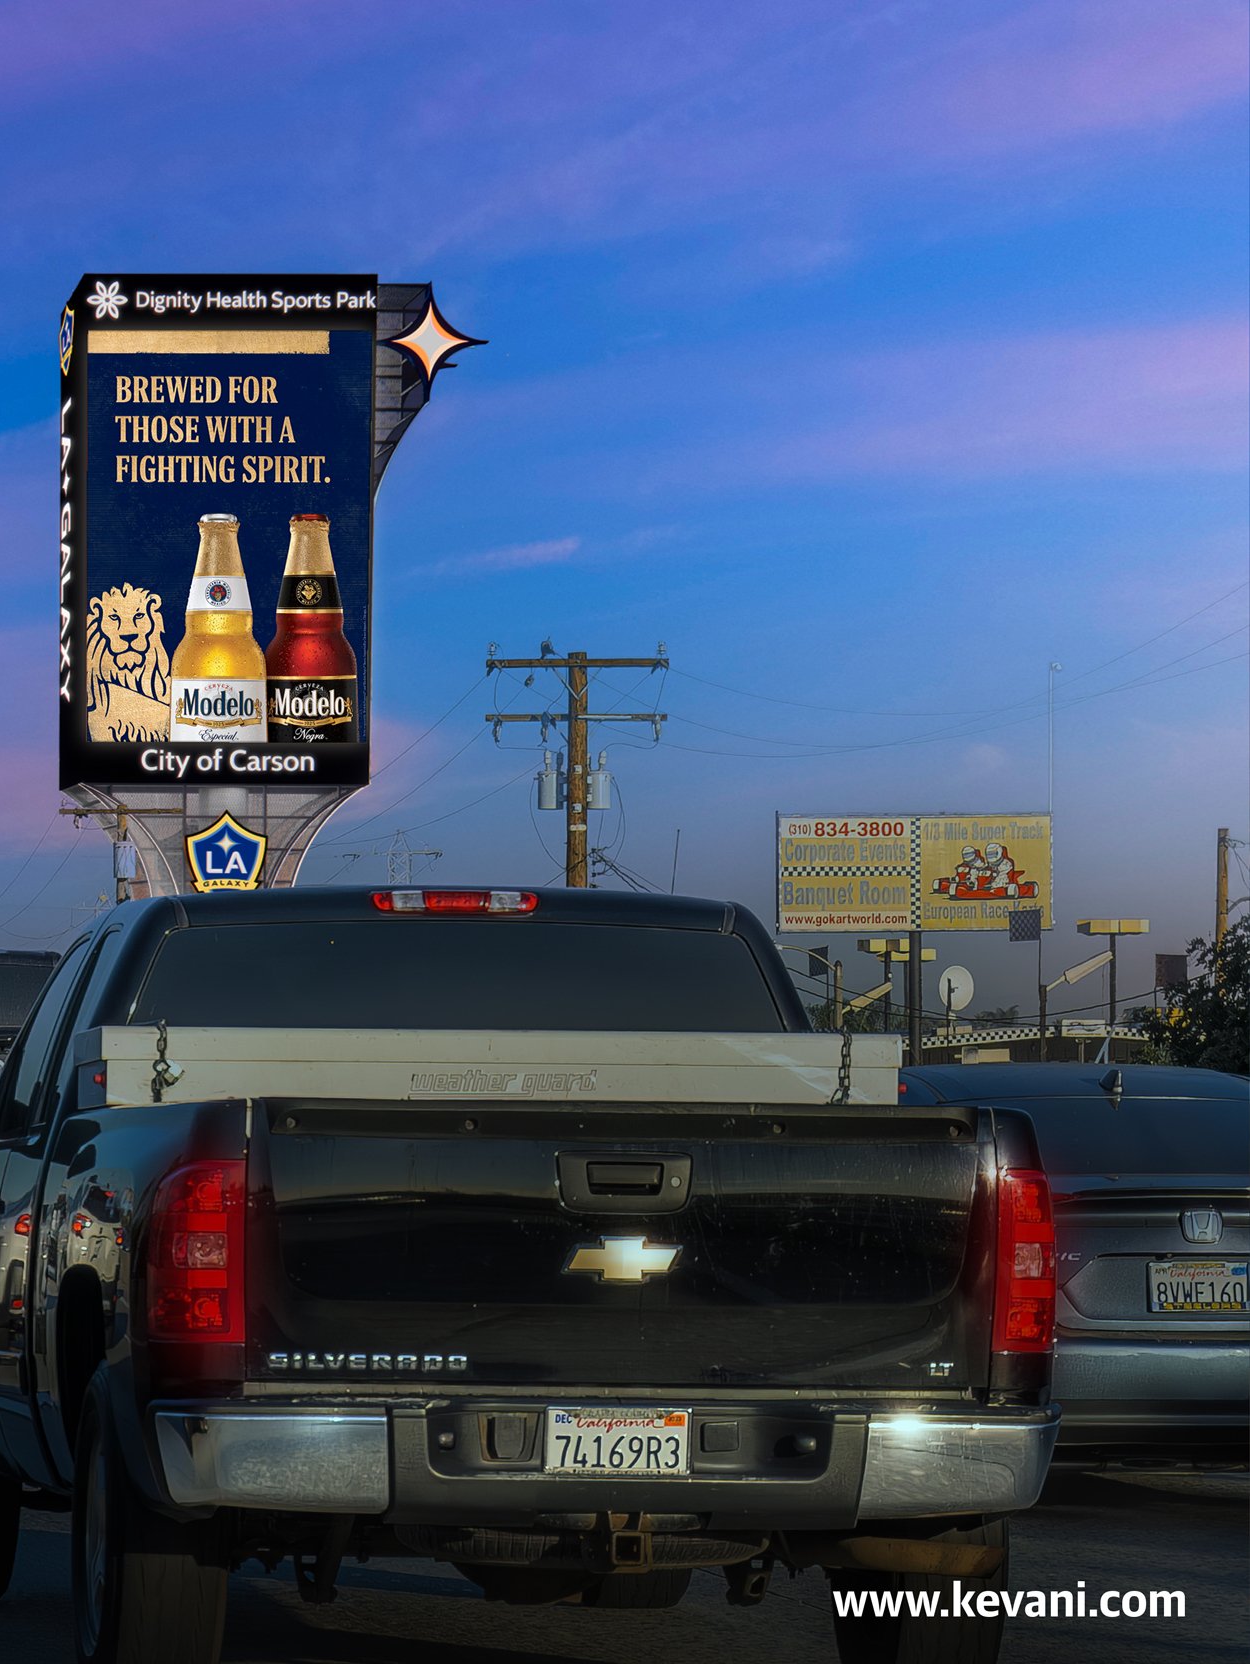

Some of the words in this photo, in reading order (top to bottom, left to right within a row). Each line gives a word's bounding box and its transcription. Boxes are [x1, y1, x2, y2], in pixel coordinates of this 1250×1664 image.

[136, 290, 202, 313] Dignity
[206, 290, 267, 309] Health
[271, 290, 331, 313] Sports
[336, 290, 376, 309] Park
[116, 376, 222, 404] BREWED
[228, 376, 278, 404] FOR
[114, 415, 200, 443] THOSE
[205, 415, 273, 443] WITH
[278, 416, 296, 443] A
[115, 455, 235, 483] FIGHTING
[242, 455, 331, 483] SPIRIT.
[204, 683, 234, 692] CERVEZA
[294, 683, 324, 692] CERVEZA
[183, 688, 255, 717] Modelo
[275, 688, 346, 717] Modelo
[198, 729, 237, 742] Especial
[293, 727, 325, 743] Negra
[141, 749, 190, 778] City
[197, 748, 223, 771] of
[229, 749, 316, 772] Carson
[789, 824, 811, 836] (310)
[814, 821, 904, 837] 834-3800
[944, 822, 968, 840] Mile
[971, 821, 1007, 841] Super
[1009, 821, 1043, 839] Track
[206, 850, 248, 874] LA
[785, 838, 855, 865] Corporate
[859, 838, 907, 861] Events
[783, 881, 854, 911] Banquet
[859, 880, 907, 904] Room
[785, 913, 908, 926] www.gokartworld.com
[923, 902, 977, 923] European
[980, 901, 1009, 918] Race
[410, 1070, 517, 1092] weather
[521, 1070, 597, 1097] guard
[268, 1353, 468, 1371] SILVERADO
[930, 1362, 954, 1376] LT
[555, 1414, 572, 1424] DEC
[576, 1418, 656, 1433] California
[555, 1435, 680, 1469] 74169R3
